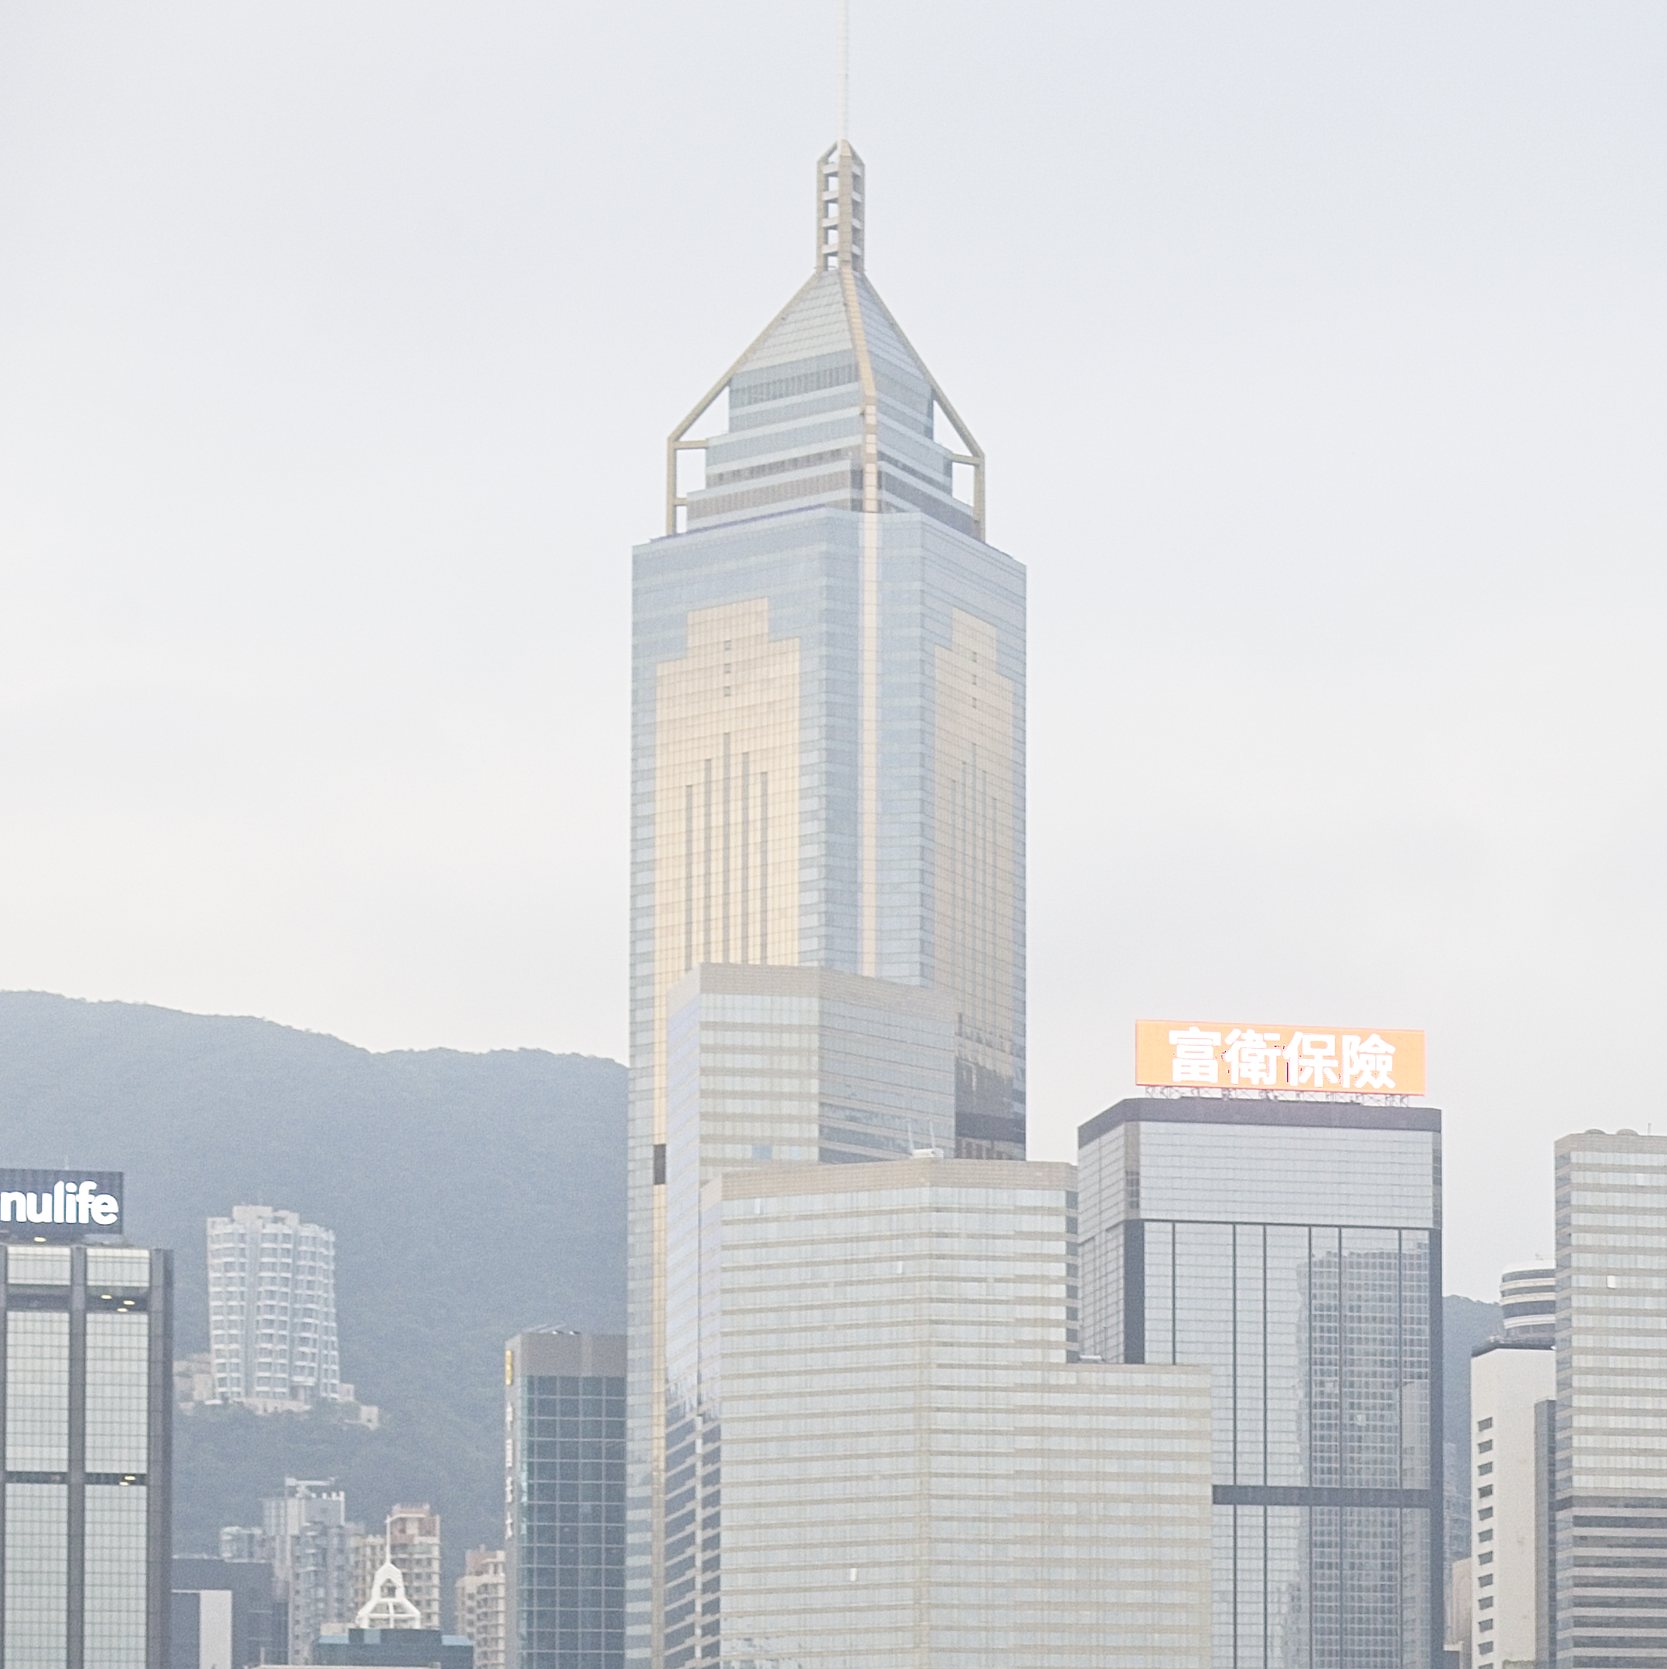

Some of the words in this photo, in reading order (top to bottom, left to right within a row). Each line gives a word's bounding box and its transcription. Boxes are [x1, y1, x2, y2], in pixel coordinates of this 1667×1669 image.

[1168, 1026, 1397, 1089] 富衛保險
[0, 1180, 119, 1225] nulife
